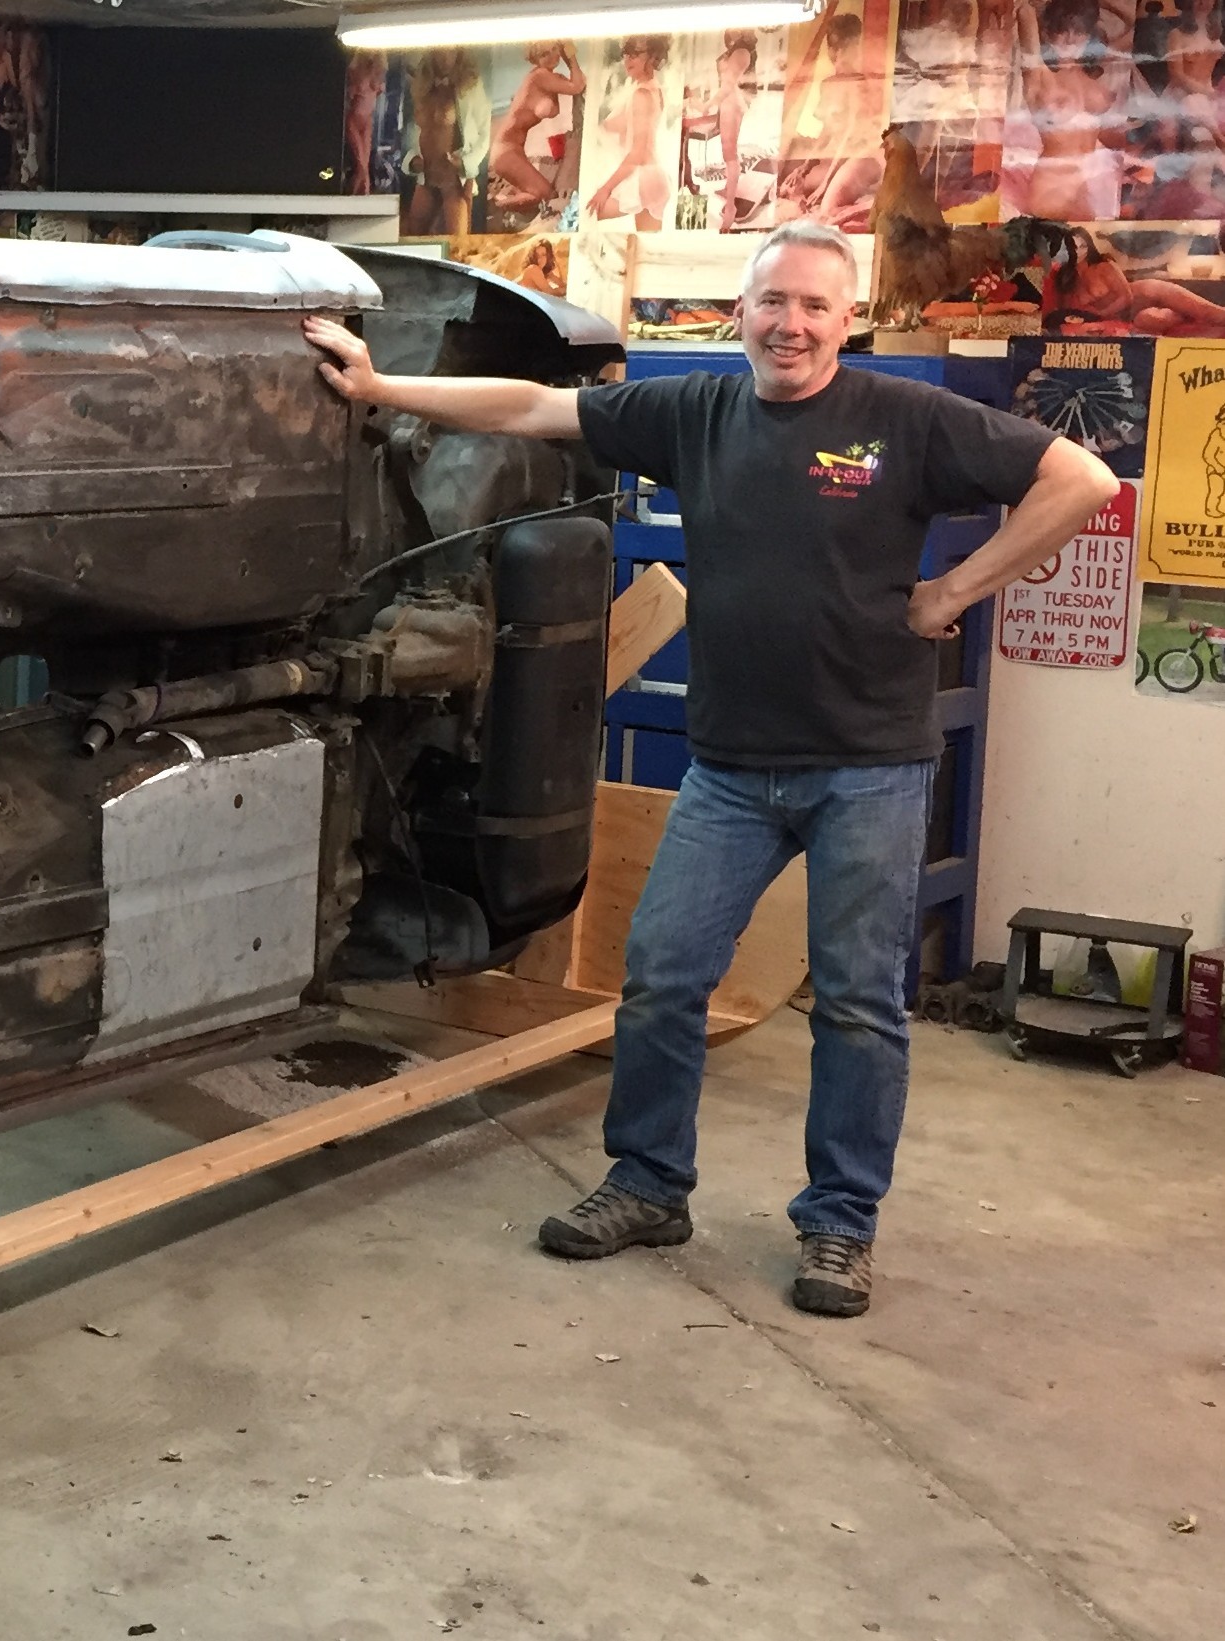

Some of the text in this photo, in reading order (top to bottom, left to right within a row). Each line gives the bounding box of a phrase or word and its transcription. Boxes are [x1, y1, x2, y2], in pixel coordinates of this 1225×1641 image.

[1074, 539, 1124, 563] THIS
[1071, 565, 1122, 589] SIDE
[1014, 589, 1115, 610] 1ST TUESDAY
[1005, 609, 1123, 630] APR THRU NOV
[1016, 629, 1024, 642] 7
[1030, 631, 1054, 645] AM
[1068, 633, 1078, 647] 5
[1085, 635, 1109, 650] PM
[1006, 646, 1116, 667] TOW AWAY ZONE
